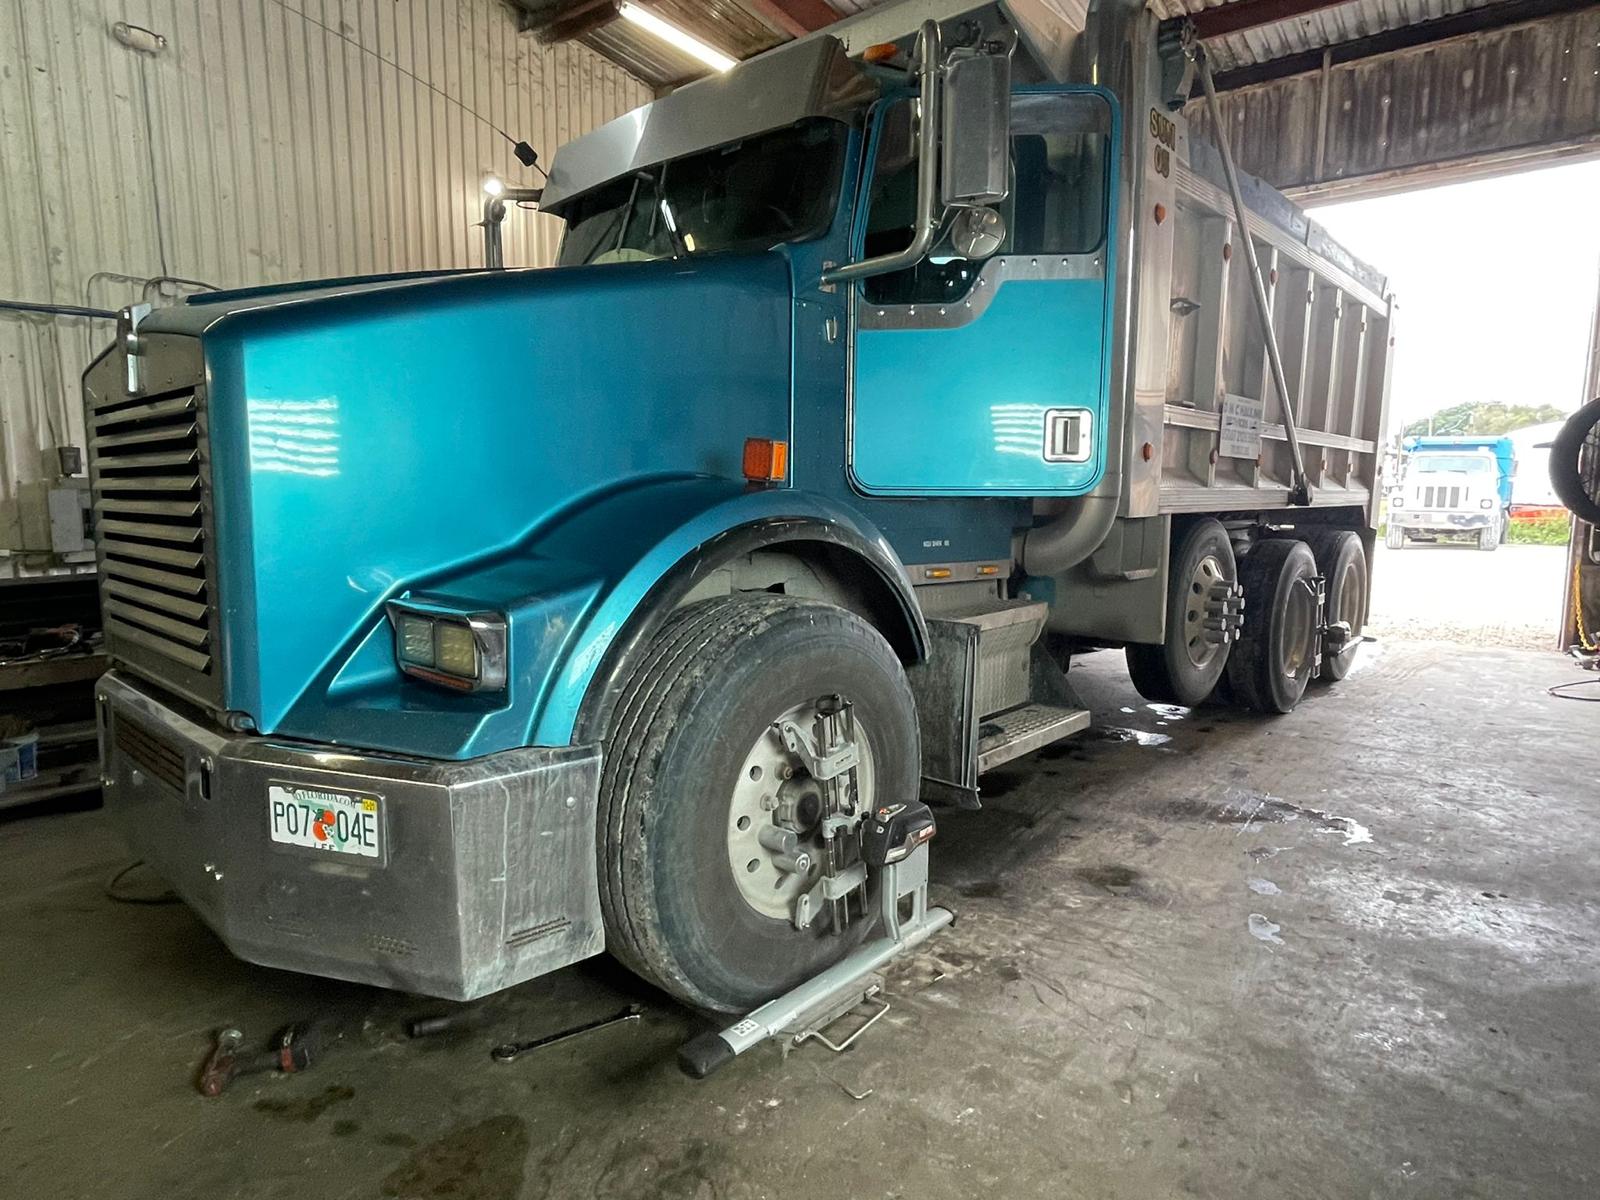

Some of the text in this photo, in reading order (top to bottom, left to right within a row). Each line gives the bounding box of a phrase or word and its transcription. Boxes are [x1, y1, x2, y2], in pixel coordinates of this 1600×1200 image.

[1150, 107, 1176, 152] SUN
[273, 801, 376, 848] P07 04E
